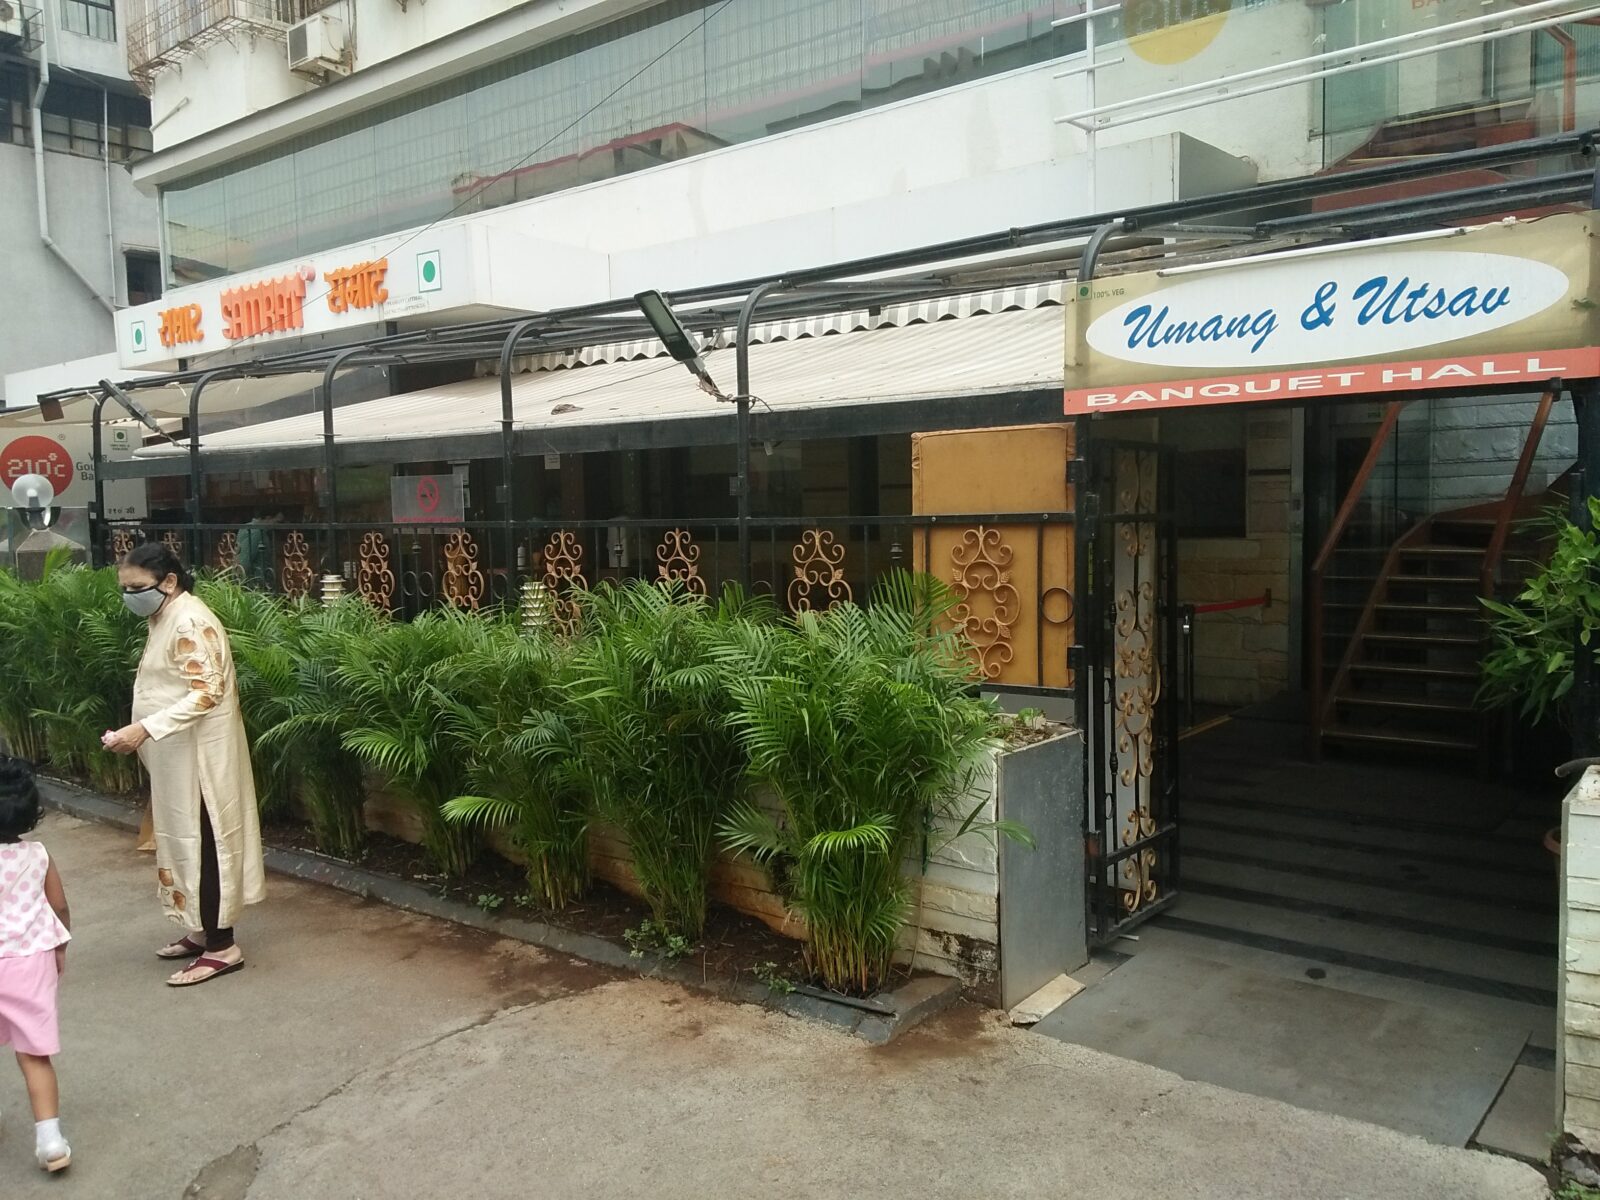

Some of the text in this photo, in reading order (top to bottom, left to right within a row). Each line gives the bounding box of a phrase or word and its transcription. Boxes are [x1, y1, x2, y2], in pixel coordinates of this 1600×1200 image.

[220, 272, 306, 340] SAMRAT
[323, 257, 389, 313] सम्राट
[1112, 288, 1125, 296] VEG
[1123, 275, 1511, 354] Umang & Utsav
[1086, 357, 1567, 408] BANQUET HALL
